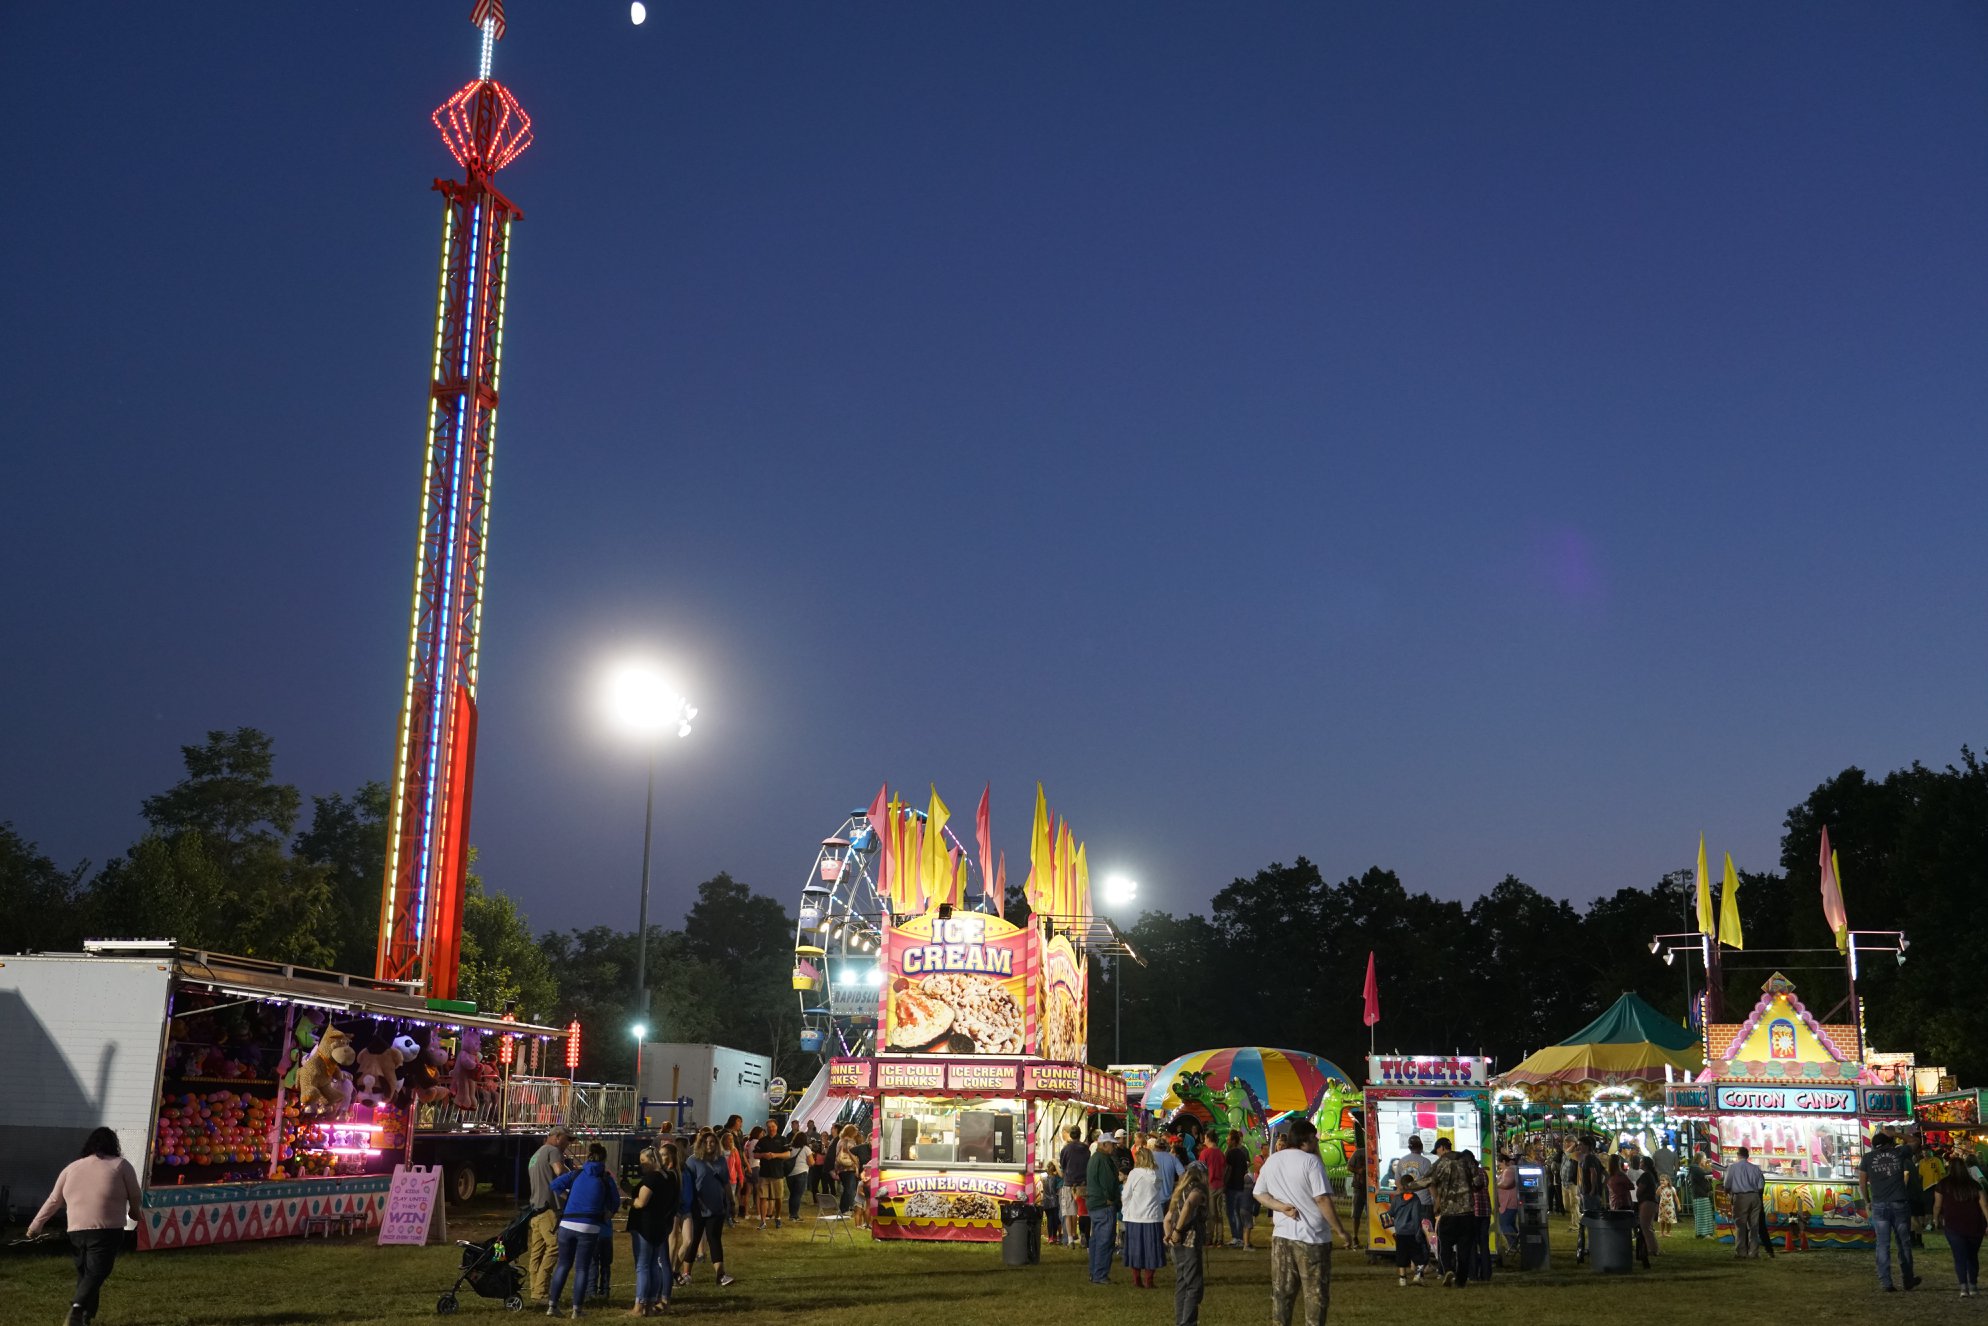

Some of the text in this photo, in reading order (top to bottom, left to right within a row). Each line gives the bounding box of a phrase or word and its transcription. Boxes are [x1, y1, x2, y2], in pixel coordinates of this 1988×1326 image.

[931, 918, 986, 945] ICE
[902, 944, 1013, 977] CREAM
[881, 1065, 942, 1077] ICE COLD
[951, 1066, 1014, 1079] ICE CREAM
[1031, 1068, 1078, 1079] FUNNE
[1380, 1060, 1472, 1081] TICKETS
[885, 1075, 937, 1087] DRINKS
[962, 1077, 1002, 1089] CONES
[1036, 1079, 1078, 1090] CAKES
[1723, 1090, 1849, 1110] COTTON CANDY
[896, 1177, 1007, 1196] FUNNEL CAKES
[389, 1212, 426, 1224] WIN
